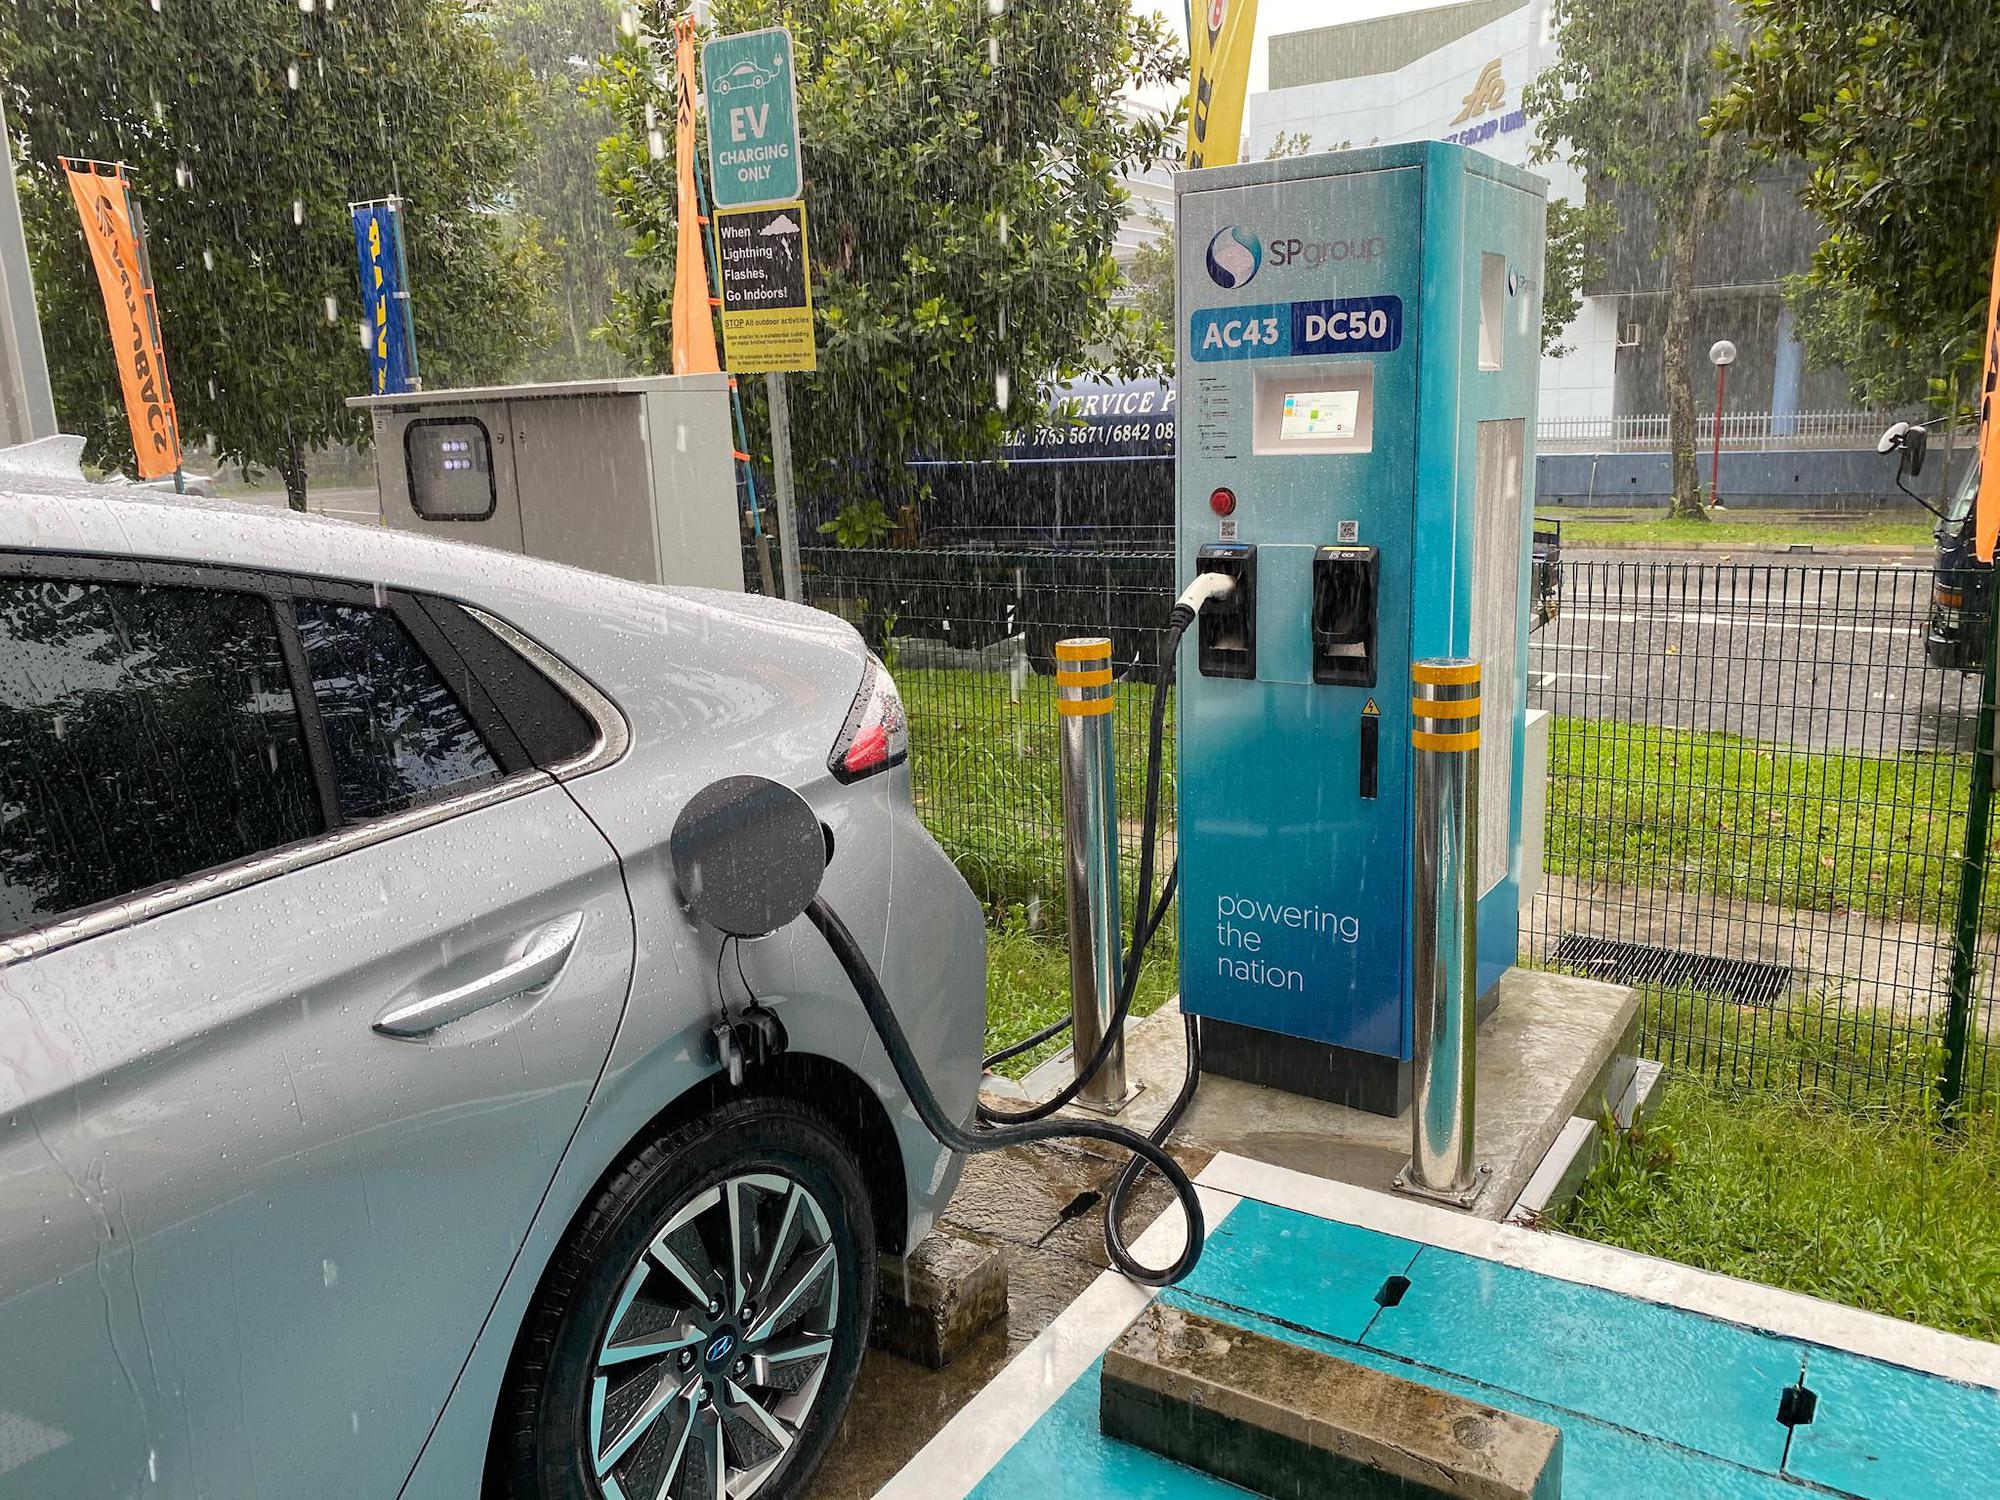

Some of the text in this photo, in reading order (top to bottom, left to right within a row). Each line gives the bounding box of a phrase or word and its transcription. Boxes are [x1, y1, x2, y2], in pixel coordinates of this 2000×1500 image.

[730, 103, 769, 142] EV
[719, 143, 789, 165] CHARGING
[738, 165, 771, 182] ONLY
[720, 226, 751, 239] When
[722, 246, 773, 262] Lightning
[724, 268, 768, 281] Flashes,
[726, 286, 788, 301] Go Indoors!
[724, 318, 744, 327] STOP
[1203, 310, 1388, 349] AC43 DC50
[1001, 429, 1025, 446] EL:
[1069, 423, 1151, 445] 5671/6842
[1154, 422, 1176, 439] 08
[1218, 895, 1359, 943] powering
[1217, 921, 1261, 952] the
[1218, 956, 1303, 992] nation
